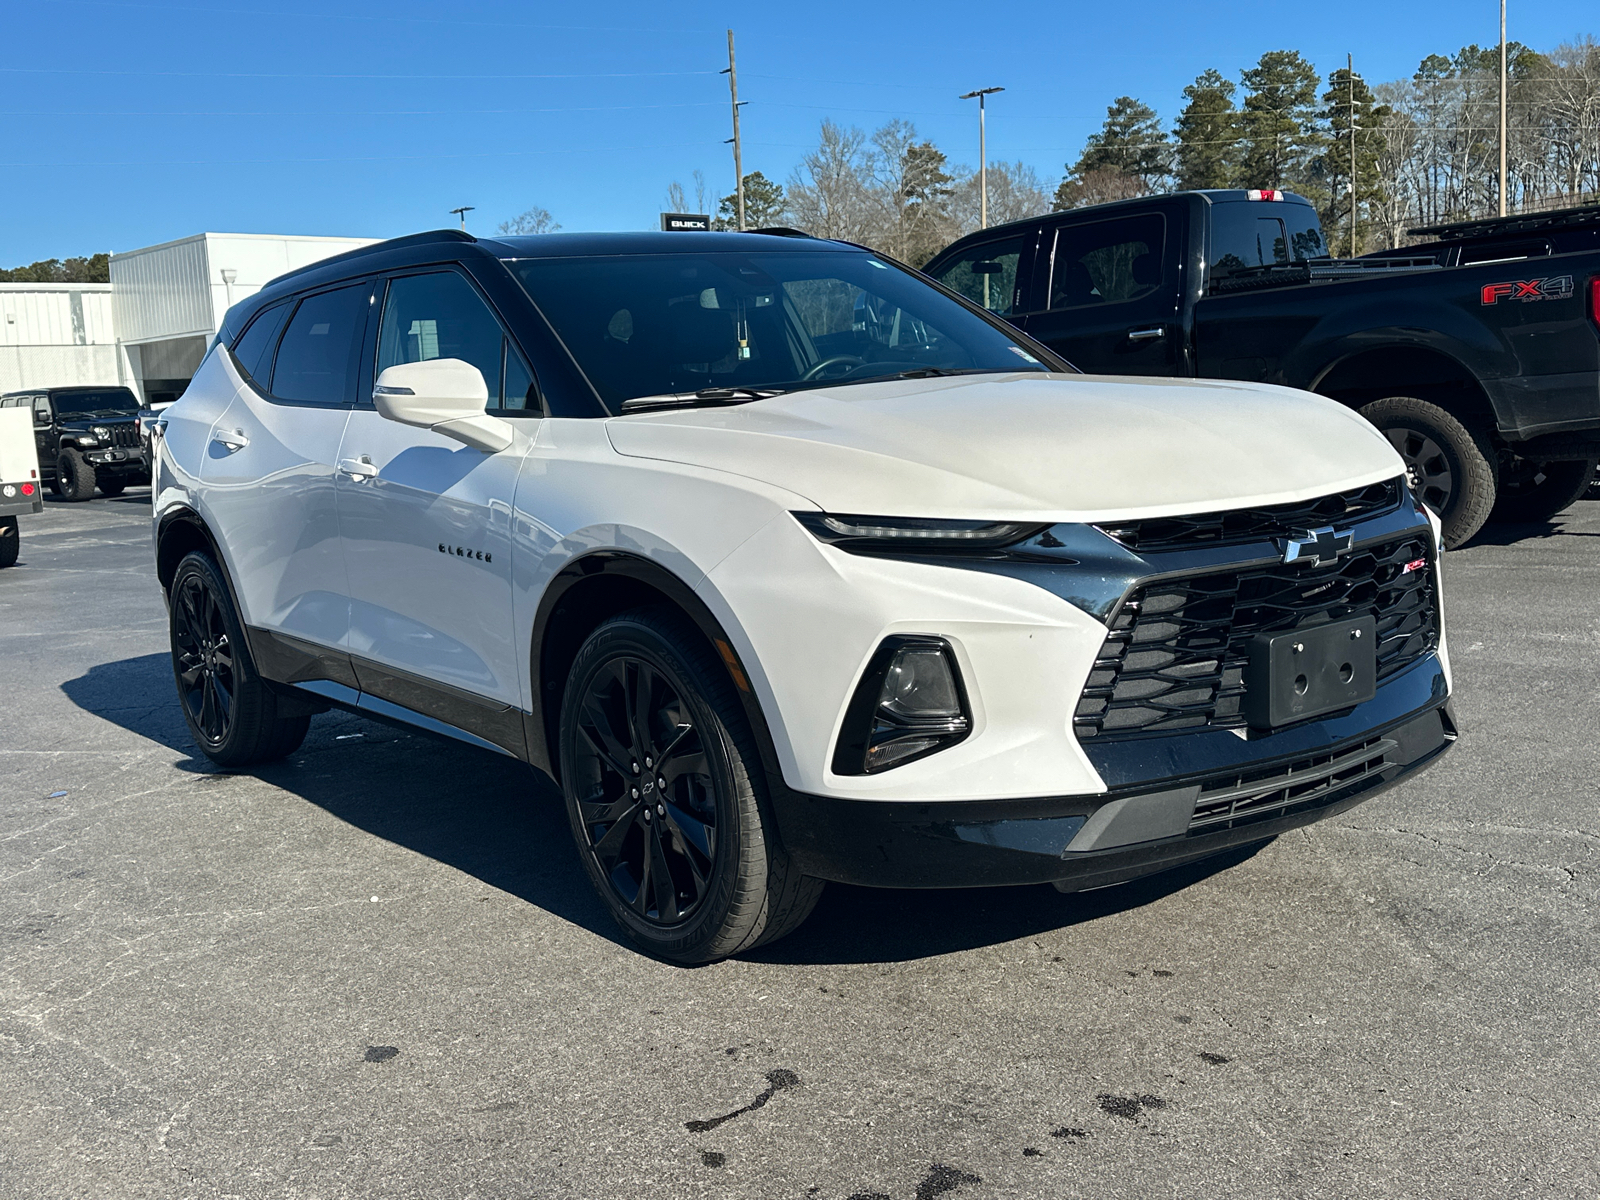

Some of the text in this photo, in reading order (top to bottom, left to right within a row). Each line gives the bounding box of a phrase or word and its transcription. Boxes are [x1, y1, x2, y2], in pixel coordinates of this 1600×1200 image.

[671, 220, 706, 229] BUICK
[1481, 275, 1574, 306] FX4
[438, 543, 493, 564] BLAZER
[1402, 557, 1426, 575] RS
